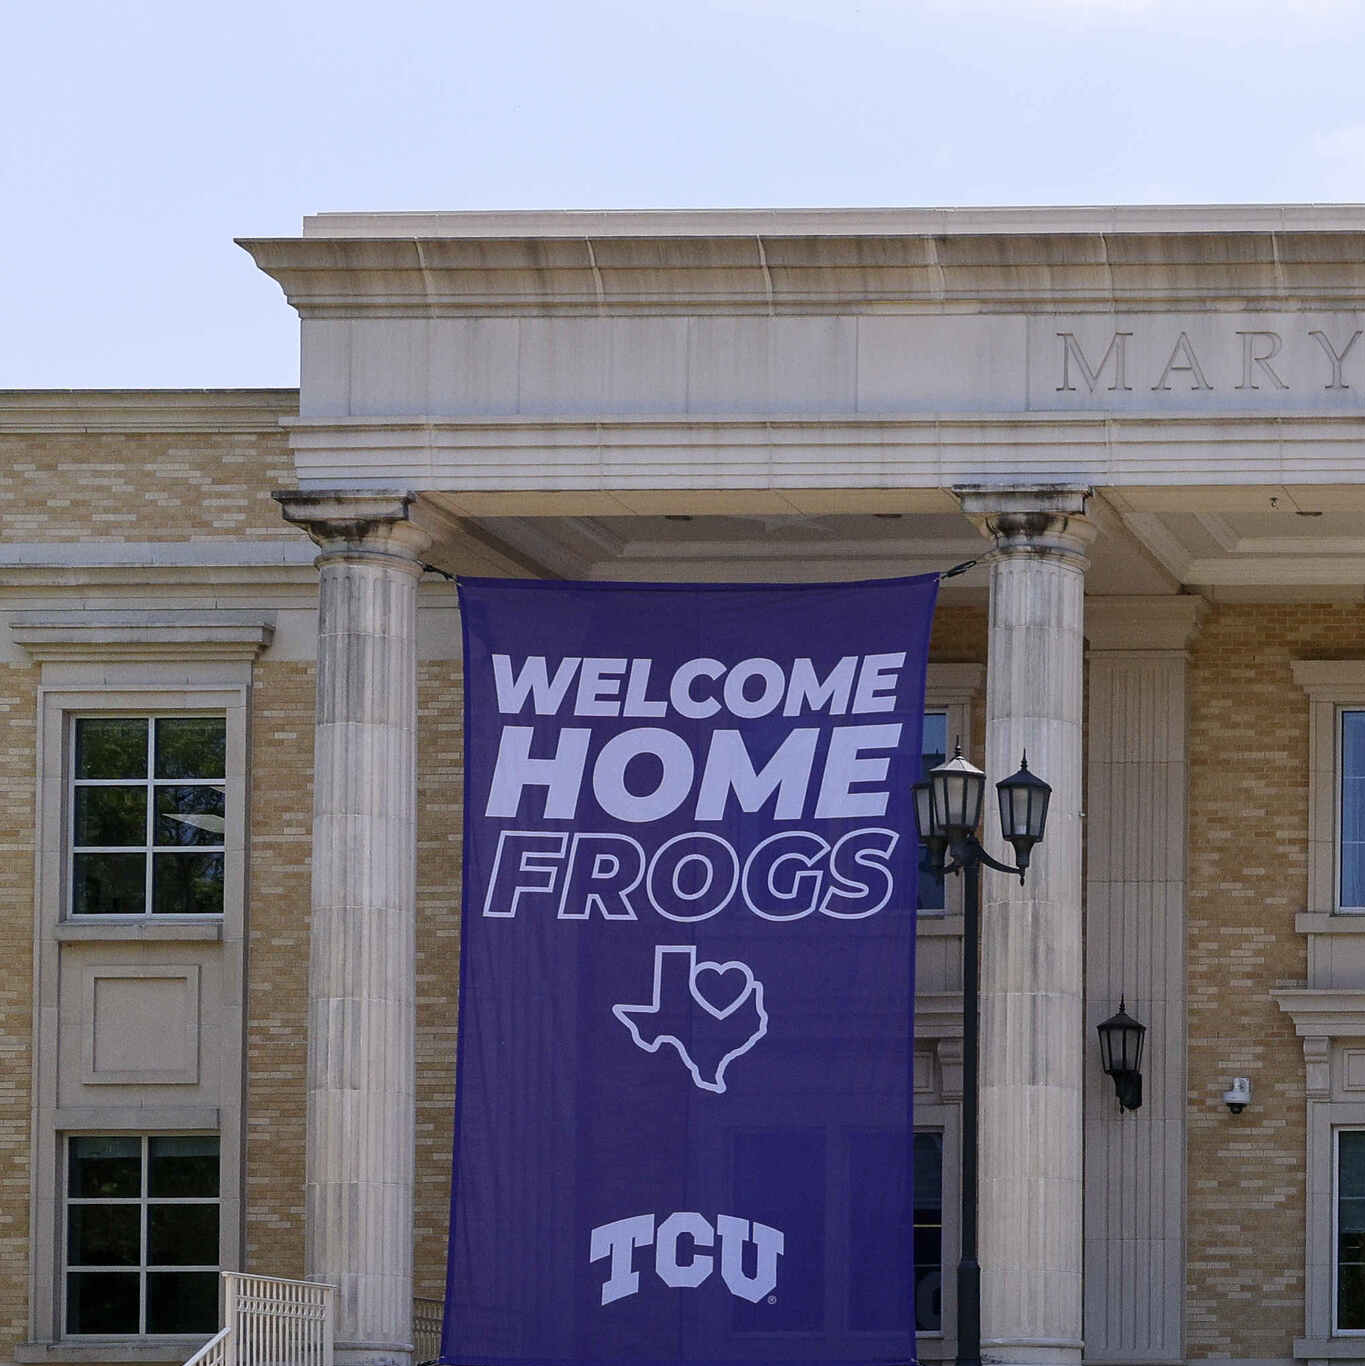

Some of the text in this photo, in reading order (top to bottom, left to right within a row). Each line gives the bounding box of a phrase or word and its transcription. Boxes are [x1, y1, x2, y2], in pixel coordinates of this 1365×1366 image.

[1056, 330, 1365, 393] MARY
[491, 652, 906, 719] WELCOME
[485, 723, 903, 822] HOME
[482, 828, 899, 922] FROGS
[589, 1211, 785, 1306] TCU
